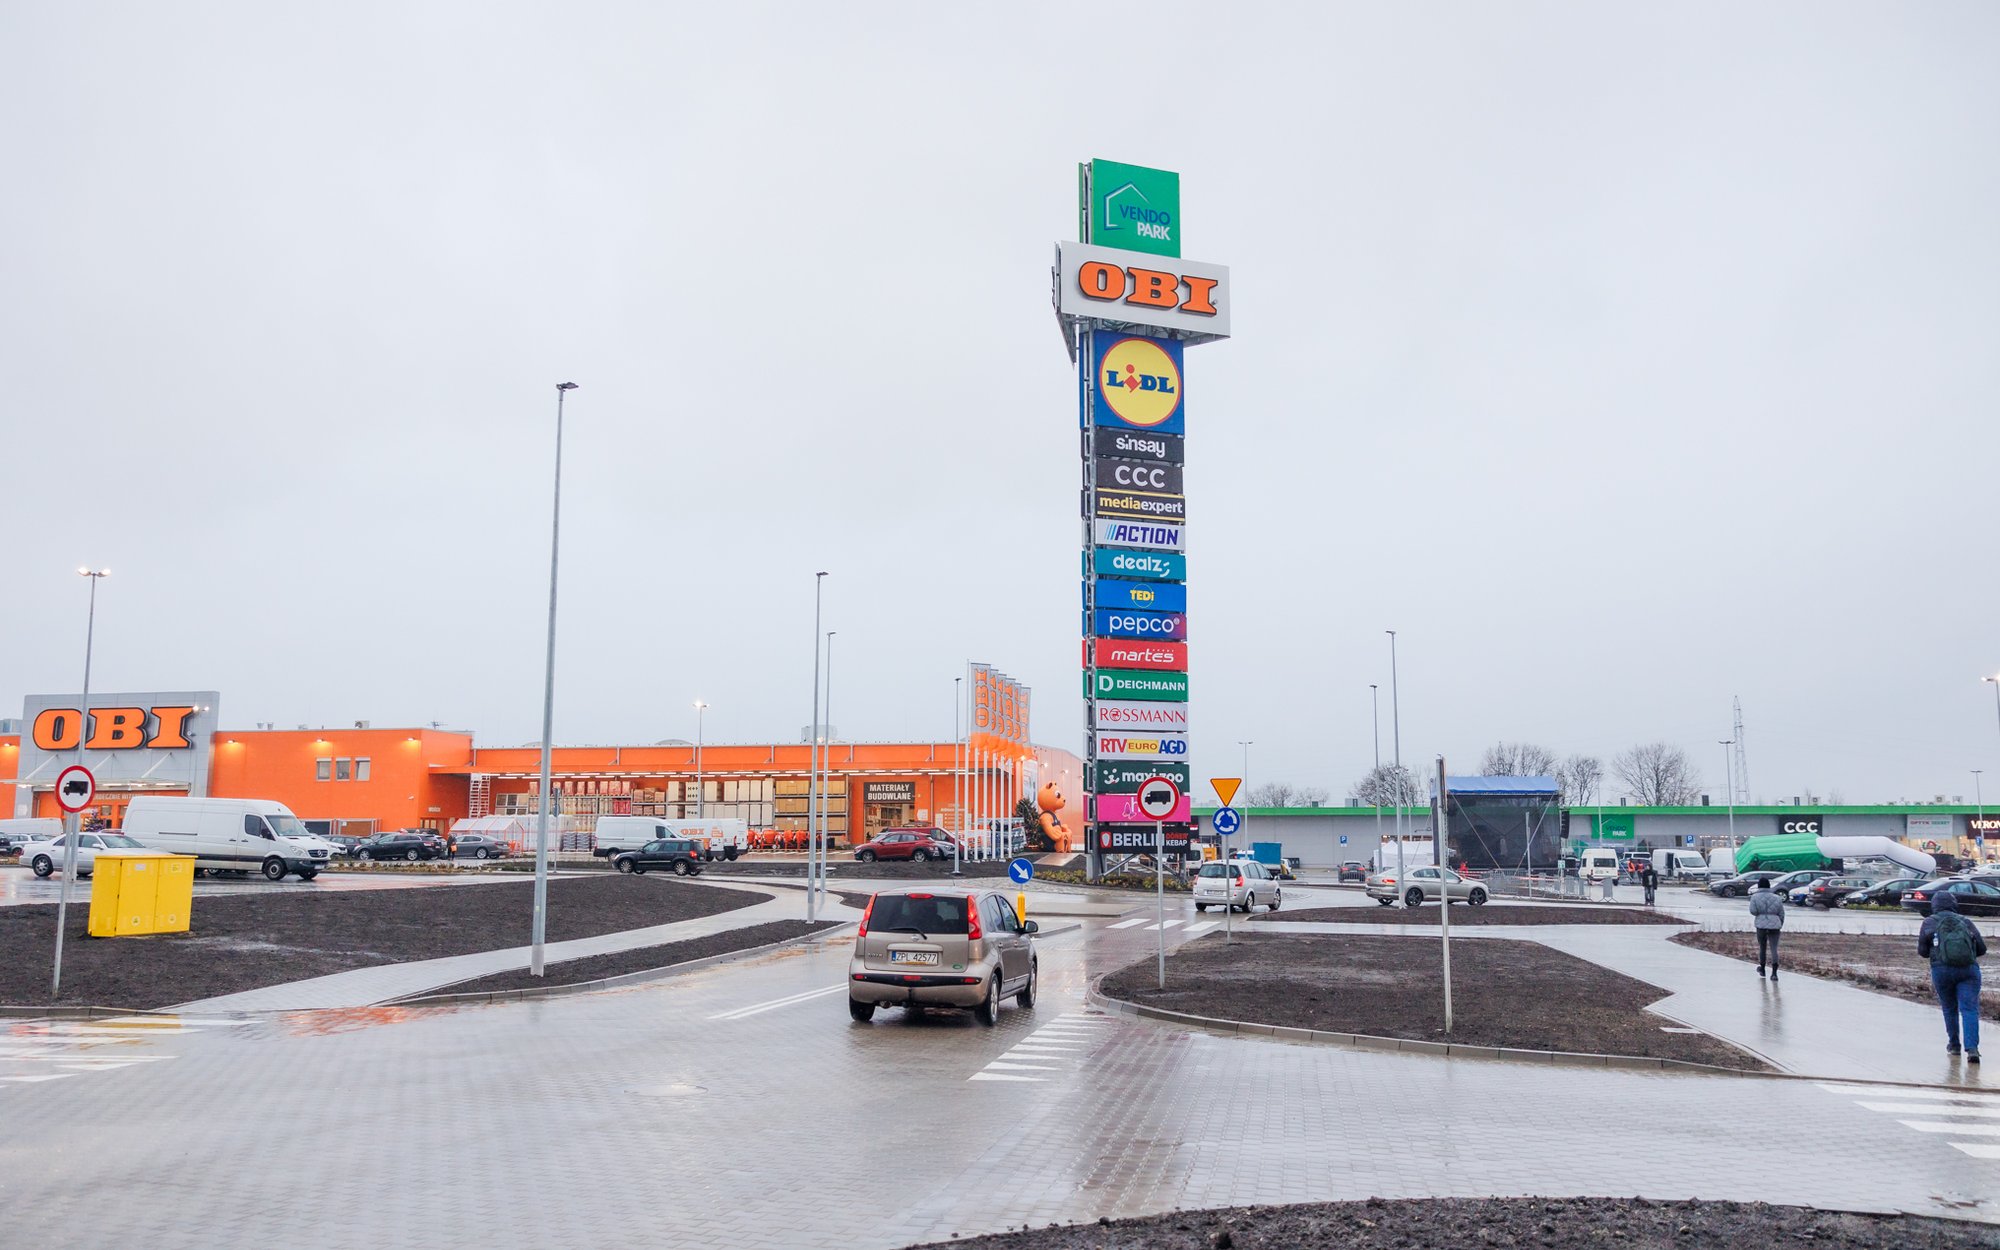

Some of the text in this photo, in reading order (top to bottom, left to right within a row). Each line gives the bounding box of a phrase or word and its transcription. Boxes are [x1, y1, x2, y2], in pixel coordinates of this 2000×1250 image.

[1119, 204, 1171, 225] VENDO
[1137, 222, 1171, 241] PARK
[1078, 260, 1218, 317] OBI
[1115, 434, 1166, 458] sinsay
[1114, 465, 1166, 489] CCC
[1099, 496, 1183, 514] mediaexpert
[1114, 524, 1179, 546] ACTION
[1116, 680, 1186, 691] DEICHMANN
[1100, 707, 1187, 724] ROSSMANN
[32, 706, 195, 751] OBI
[1100, 738, 1187, 755] RTV EURO AGD
[869, 783, 910, 792] MATERIAŁY
[867, 792, 912, 801] BUDOWLANE
[1783, 821, 1818, 833] CCC
[1165, 839, 1188, 847] KEBAP
[896, 953, 936, 962] ZPL 42577
